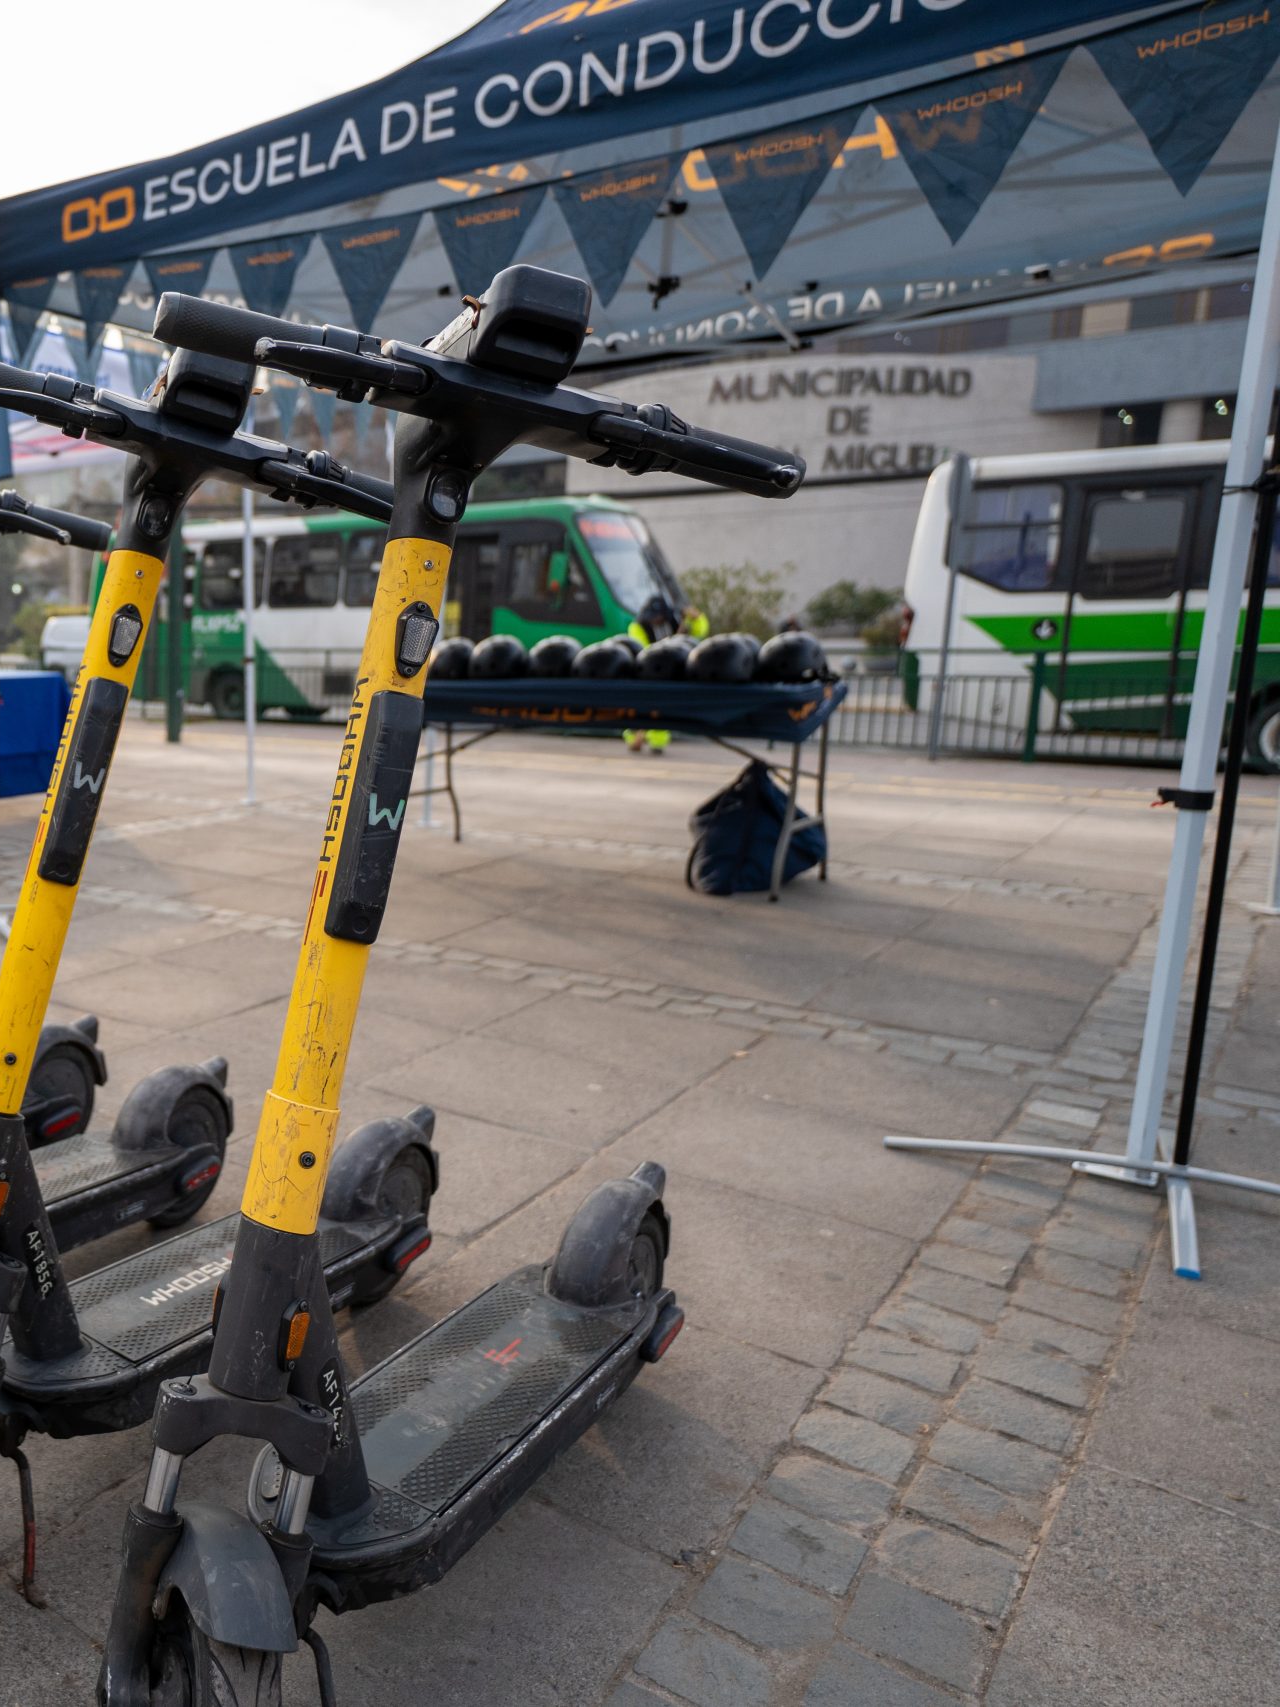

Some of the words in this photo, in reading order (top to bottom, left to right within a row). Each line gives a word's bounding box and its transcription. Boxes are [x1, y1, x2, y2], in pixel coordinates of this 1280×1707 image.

[1136, 8, 1270, 59] WHOOSH
[142, 118, 367, 221] ESCUELA
[380, 86, 459, 155] DE
[474, 0, 967, 129] CONDUCC
[917, 80, 1024, 121] WHOOSH
[734, 132, 825, 163] WHOOSH
[580, 173, 658, 202] WHOOSH
[708, 367, 974, 403] MUNICIPALIDAD
[827, 405, 872, 435] DE
[72, 760, 106, 795] W
[367, 792, 406, 832] W
[26, 1228, 52, 1296] AF1856
[139, 1257, 233, 1306] WHOOSH
